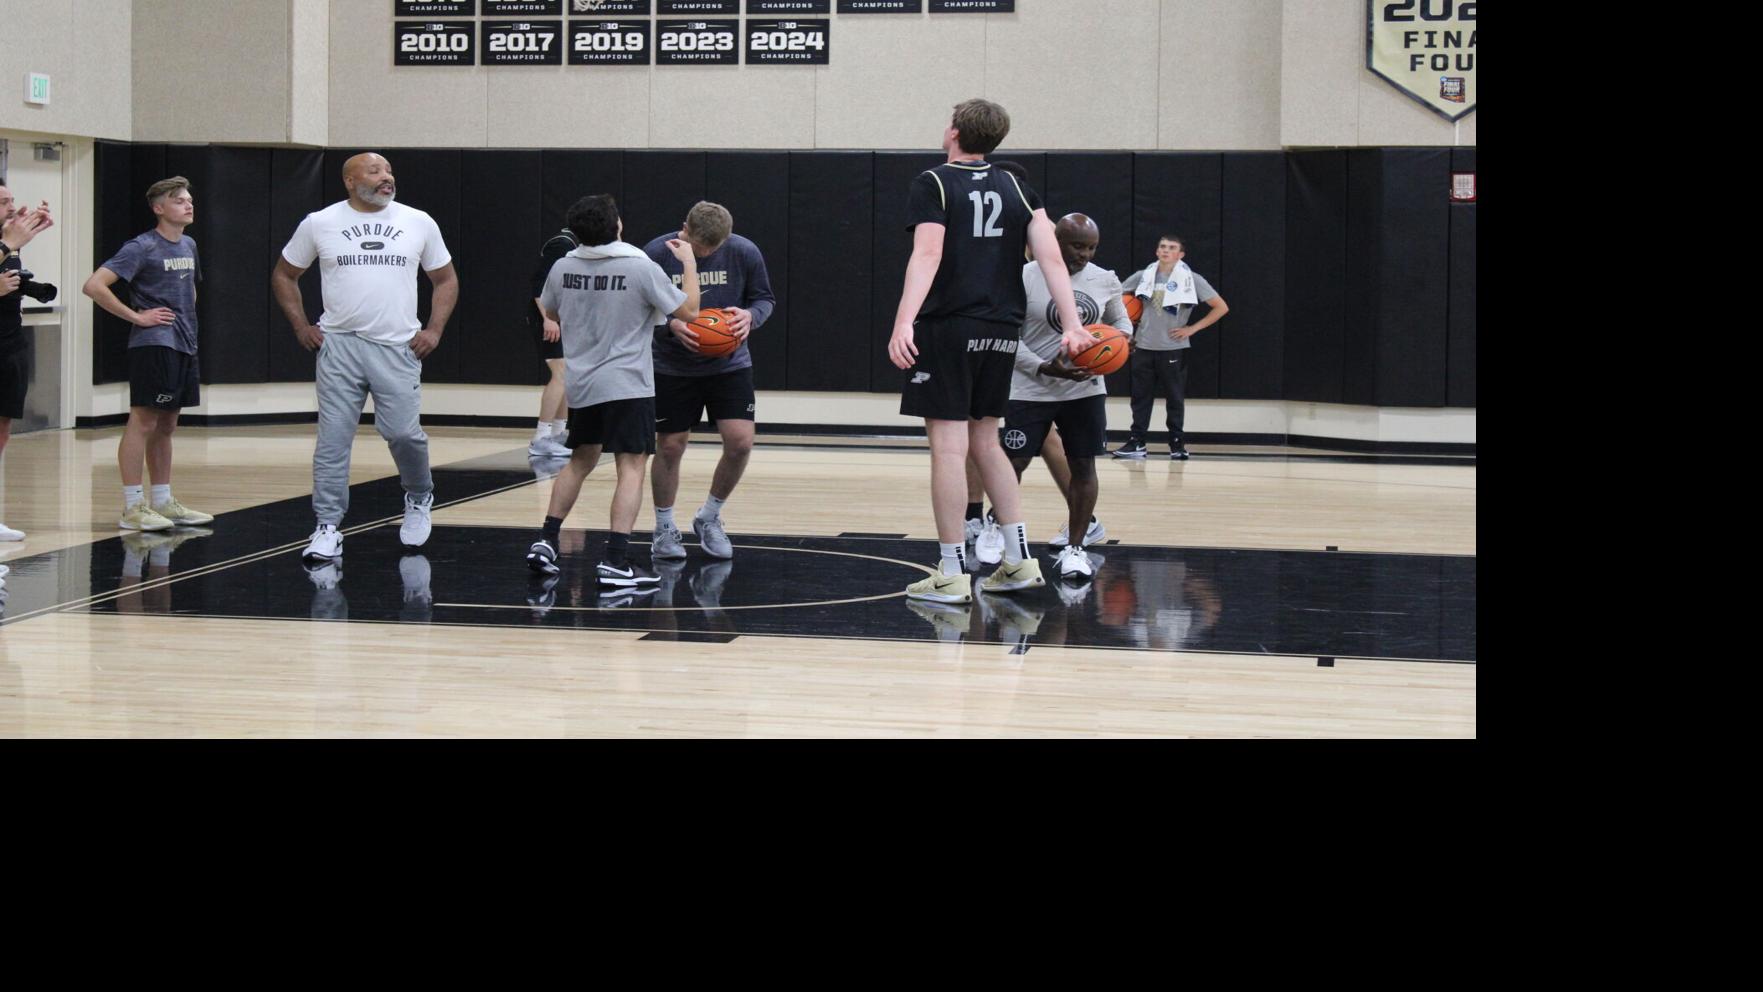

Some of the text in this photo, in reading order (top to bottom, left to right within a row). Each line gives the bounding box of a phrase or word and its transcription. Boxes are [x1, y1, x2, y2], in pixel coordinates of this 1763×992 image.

[401, 33, 469, 52] 2010
[489, 33, 555, 52] 2017
[574, 32, 644, 52] 2019
[661, 32, 734, 51] 2023
[750, 31, 825, 51] 2024
[33, 77, 48, 97] EXIT
[968, 190, 1004, 238] 12
[341, 223, 404, 241] PURDUE
[336, 254, 407, 268] BOILERMAKERS
[562, 272, 592, 290] JUST
[594, 275, 609, 291] DO
[672, 270, 728, 286] PDUE
[966, 338, 993, 352] PLAY
